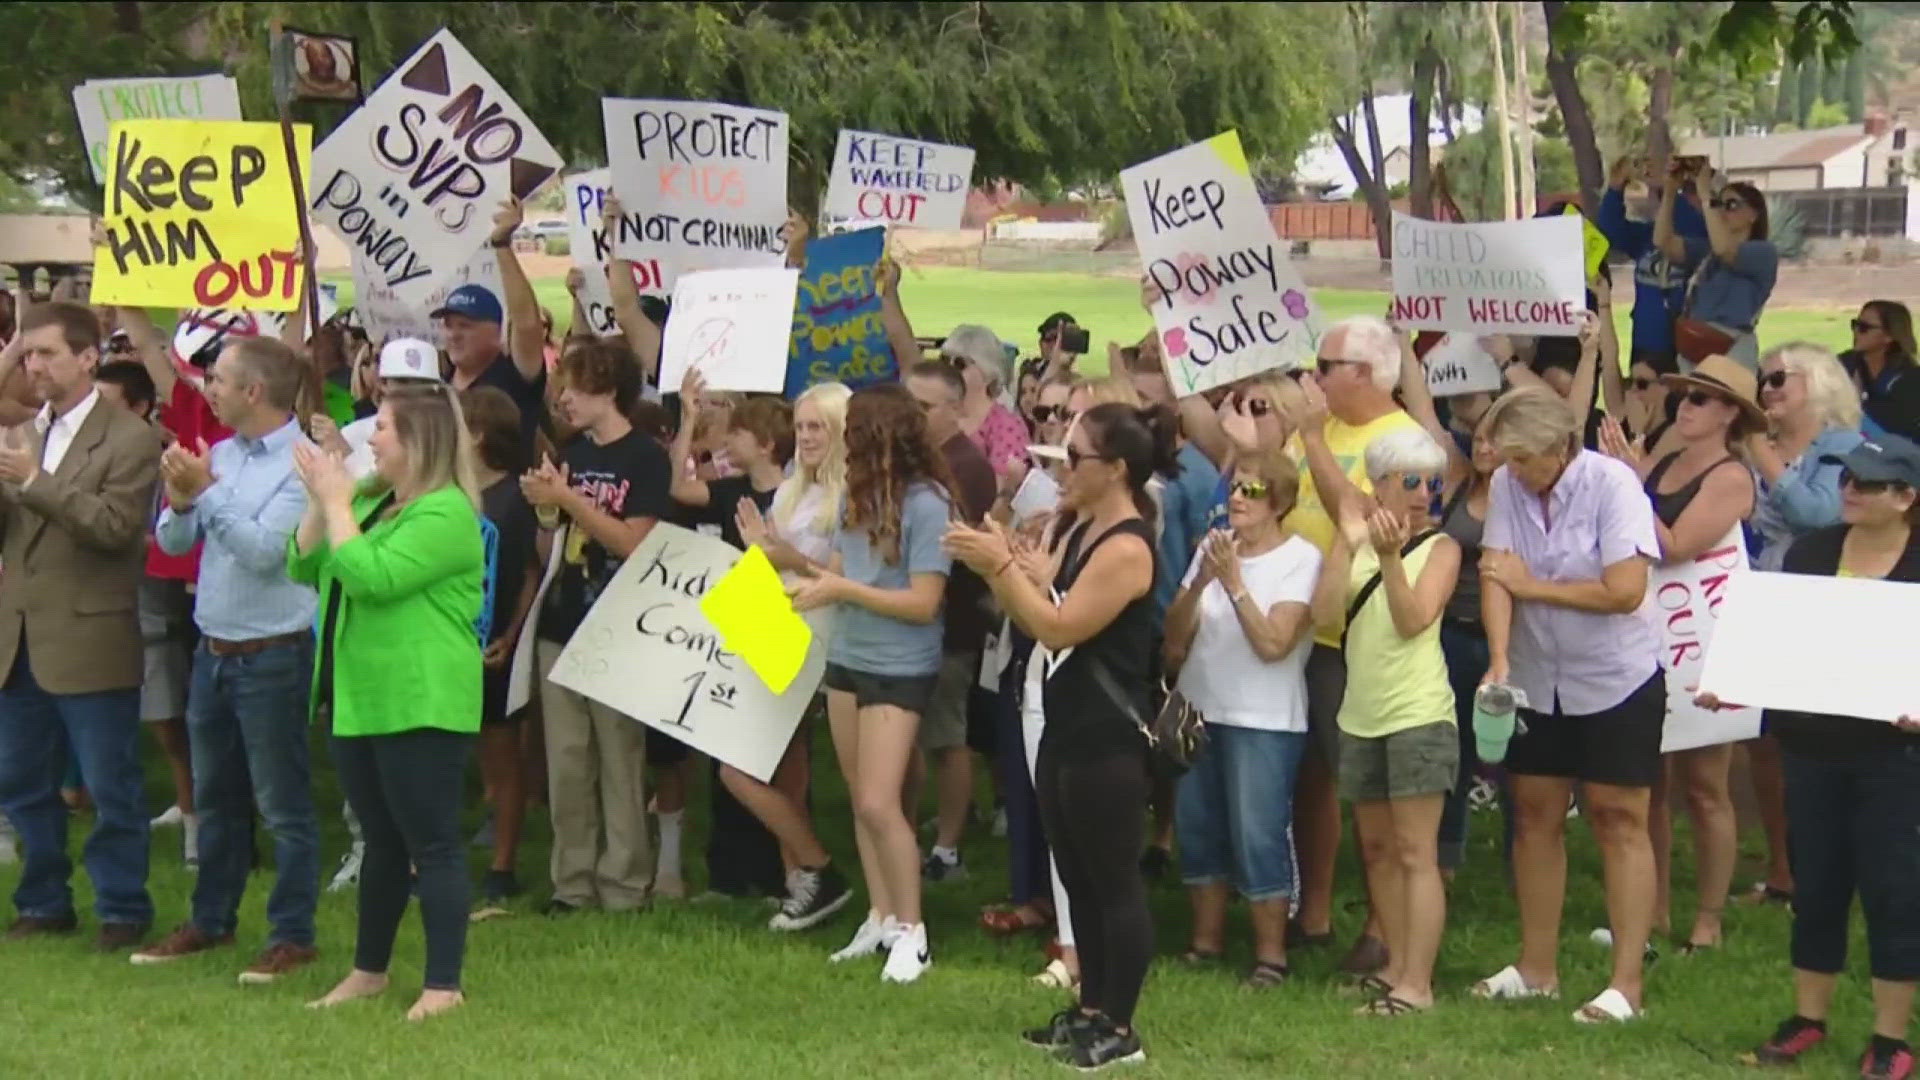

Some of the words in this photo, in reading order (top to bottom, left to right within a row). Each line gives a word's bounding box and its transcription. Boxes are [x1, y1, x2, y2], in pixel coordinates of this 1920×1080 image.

[438, 84, 523, 165] NO
[634, 112, 778, 163] PROTECT
[849, 135, 936, 168] KEEP
[381, 183, 410, 219] in
[659, 166, 745, 208] KIDS
[851, 167, 963, 193] WAKEFIELD
[858, 190, 927, 222] OUT
[107, 217, 222, 275] HIM
[620, 212, 680, 242] NOT
[682, 219, 788, 254] CRIMINALS
[1395, 221, 1487, 264] CHILD
[194, 249, 304, 307] OUT
[1415, 265, 1547, 291] PREDATORS
[1188, 295, 1289, 366] Safe
[1394, 295, 1447, 321] NOT
[1468, 297, 1576, 325] WELCOME
[639, 542, 714, 599] Kid
[636, 603, 737, 671] Come
[1656, 581, 1702, 667] OUR
